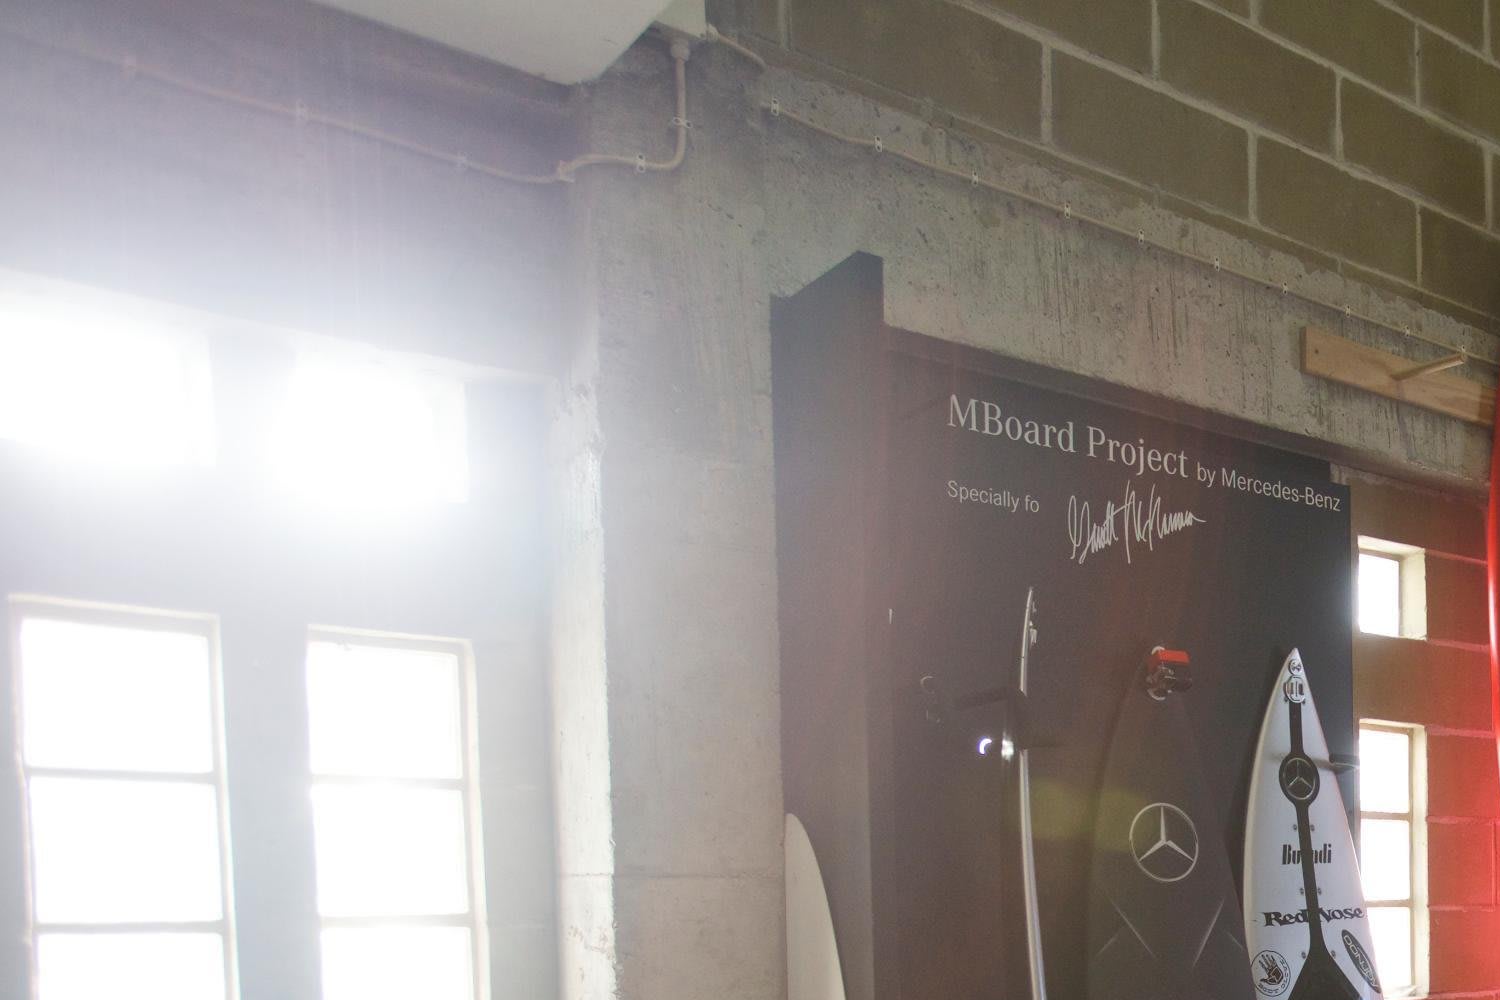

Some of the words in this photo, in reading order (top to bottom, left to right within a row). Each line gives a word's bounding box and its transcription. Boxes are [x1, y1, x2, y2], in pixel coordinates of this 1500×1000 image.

[947, 394, 1075, 453] MBoard
[1086, 425, 1189, 477] Project
[1197, 461, 1215, 489] by
[1221, 467, 1341, 512] Mercedes-Benz
[947, 480, 1020, 513] Specially
[1263, 908, 1310, 926] Red
